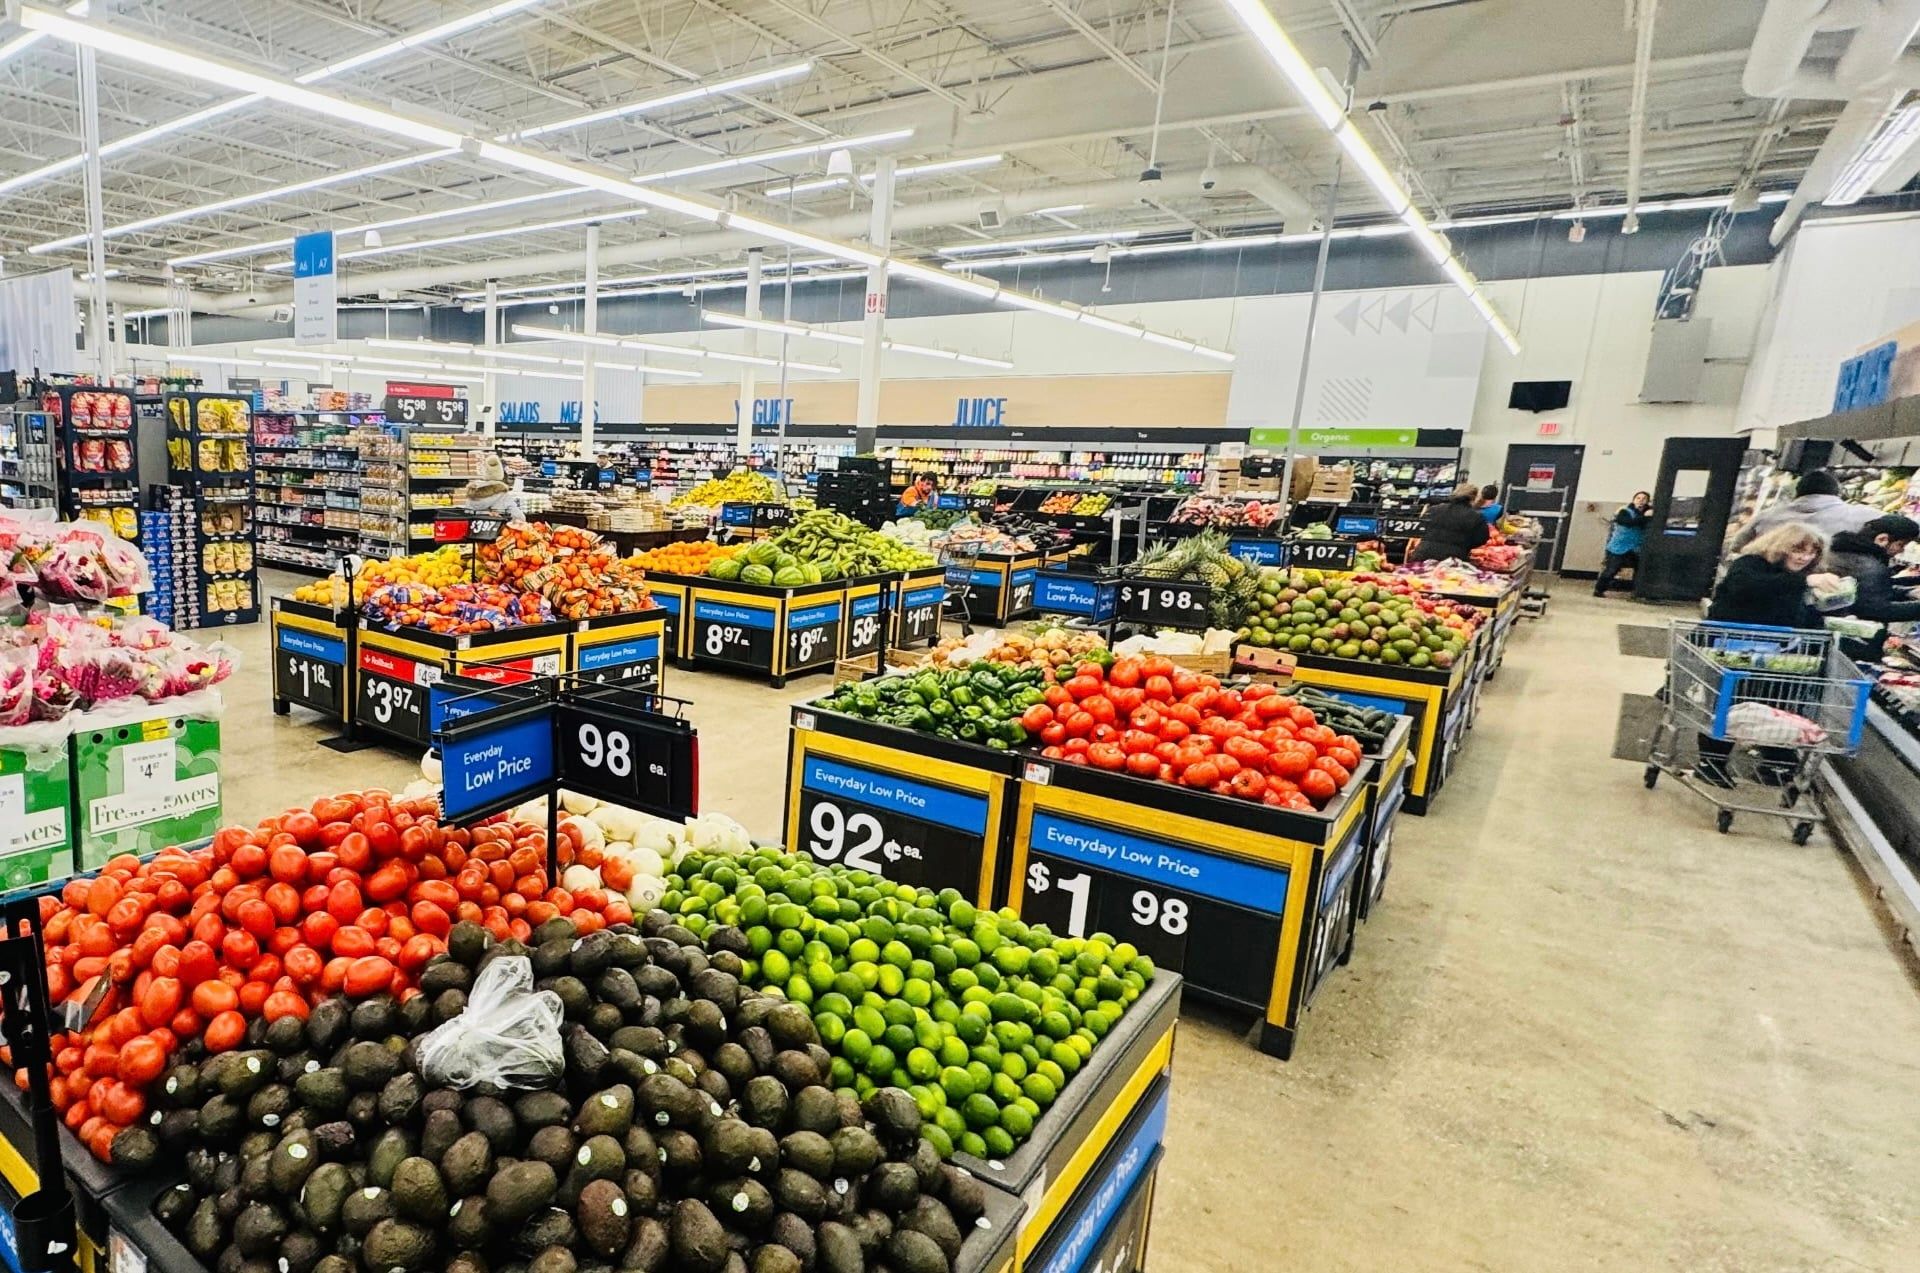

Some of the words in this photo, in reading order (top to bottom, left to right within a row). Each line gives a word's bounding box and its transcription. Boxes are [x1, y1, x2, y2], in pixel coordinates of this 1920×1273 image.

[319, 257, 328, 269] A7
[500, 401, 540, 423] SALADS
[560, 400, 599, 423] MEAS
[735, 399, 794, 425] YGURT
[953, 398, 1007, 426] JUICE
[1311, 432, 1350, 443] Organic
[1047, 582, 1075, 593] Everyday
[1046, 593, 1066, 602] Low
[1068, 593, 1095, 605] Price
[700, 606, 723, 617] Everyday
[724, 609, 735, 617] Low
[736, 611, 750, 620] Price
[283, 635, 303, 649] Everyday
[303, 641, 312, 649] Low
[312, 642, 325, 652] Price
[371, 656, 394, 670] Rollback
[585, 651, 610, 663] Everyday
[611, 650, 622, 658] Low
[622, 647, 637, 657] Price
[464, 745, 502, 765] Everyday
[578, 723, 632, 777] 98
[649, 763, 667, 776] ea.
[465, 770, 494, 791] Low
[498, 756, 531, 780] Price
[815, 768, 867, 794] Everyday
[869, 783, 893, 798] Low
[895, 787, 926, 808] Price
[903, 844, 923, 860] ea.
[1047, 826, 1117, 860] Everyday
[1120, 846, 1153, 866] Low
[1157, 855, 1200, 878] Price
[1131, 890, 1189, 935] 98
[1096, 1181, 1117, 1217] Low
[1116, 1147, 1139, 1187] Price
